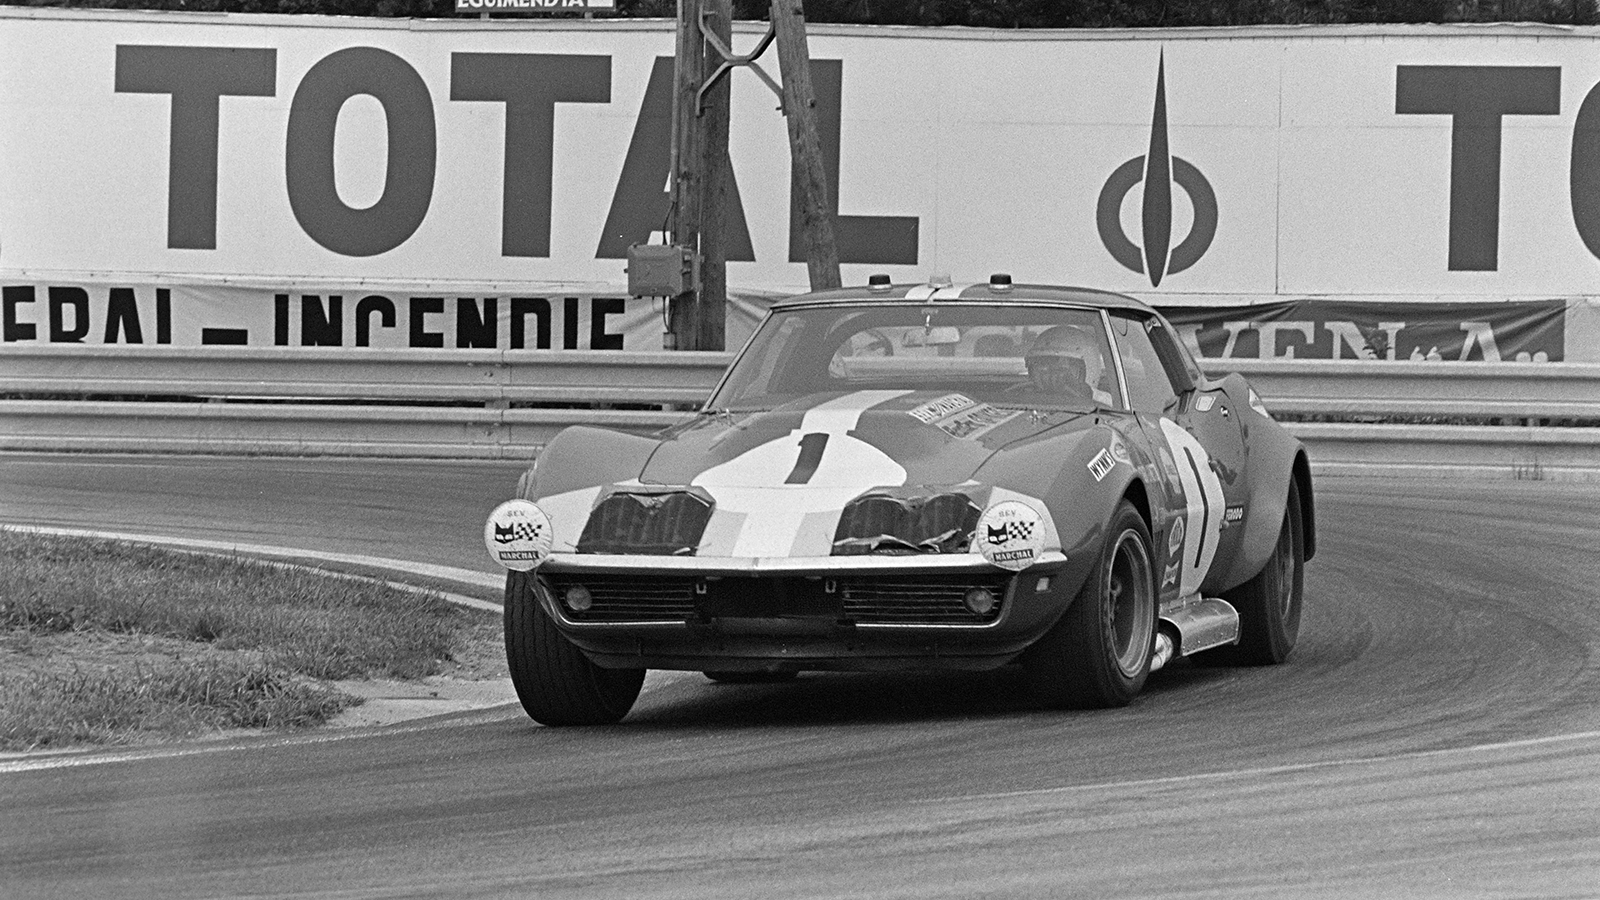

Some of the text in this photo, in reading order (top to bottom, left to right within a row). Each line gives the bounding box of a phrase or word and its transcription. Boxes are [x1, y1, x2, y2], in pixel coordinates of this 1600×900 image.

[115, 45, 919, 265] TOTAL
[1395, 64, 1600, 271] T
[784, 432, 830, 484] 1
[1183, 446, 1209, 569] 1
[500, 551, 539, 560] MARCHAL
[994, 549, 1033, 561] MARCHAL
